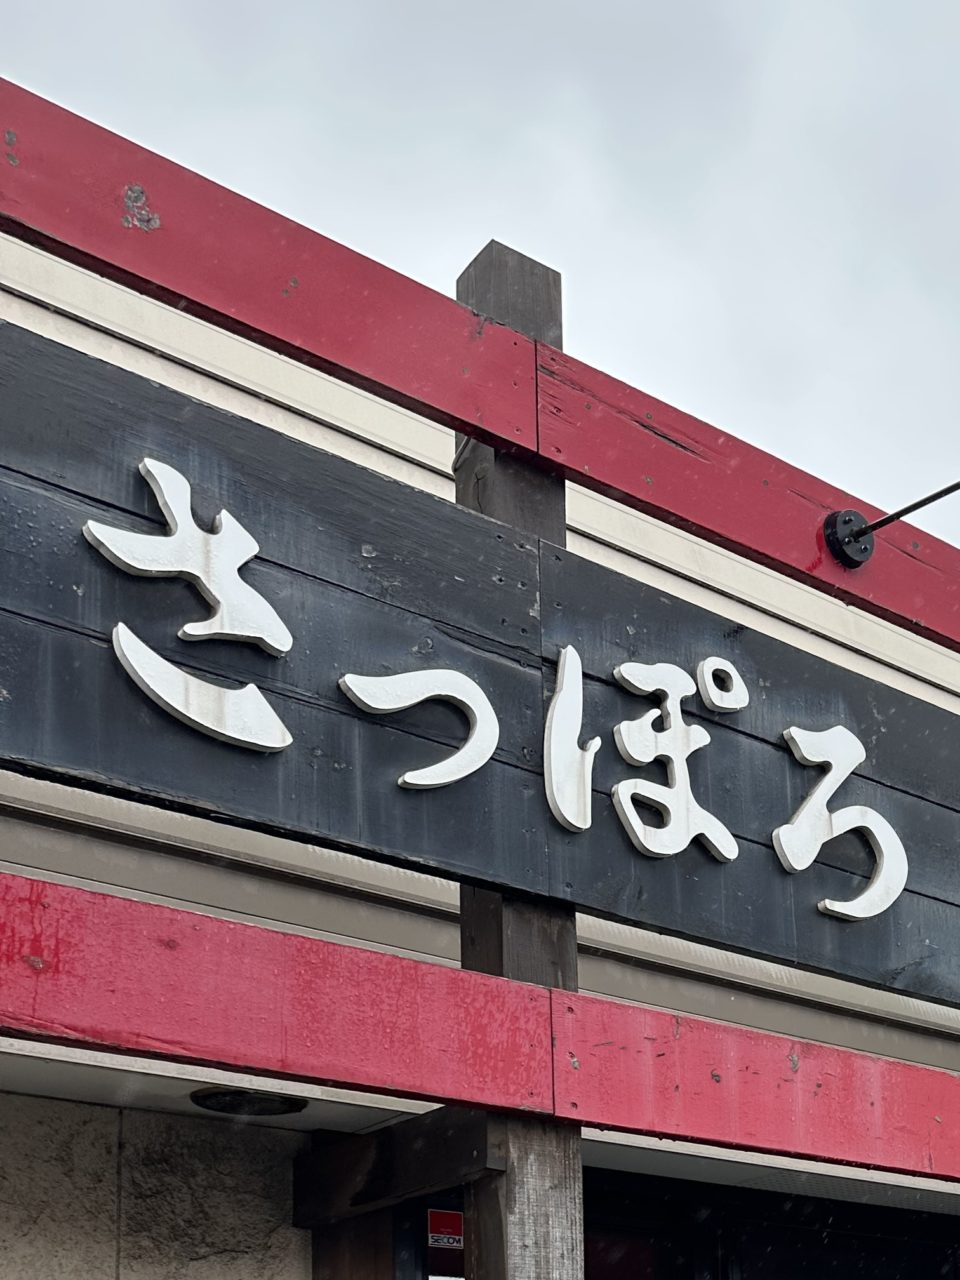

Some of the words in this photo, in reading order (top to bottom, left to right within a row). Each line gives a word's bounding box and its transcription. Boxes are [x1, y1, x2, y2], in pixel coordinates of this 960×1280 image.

[82, 457, 909, 921] さっぽろ
[431, 1236, 461, 1245] SECOM
